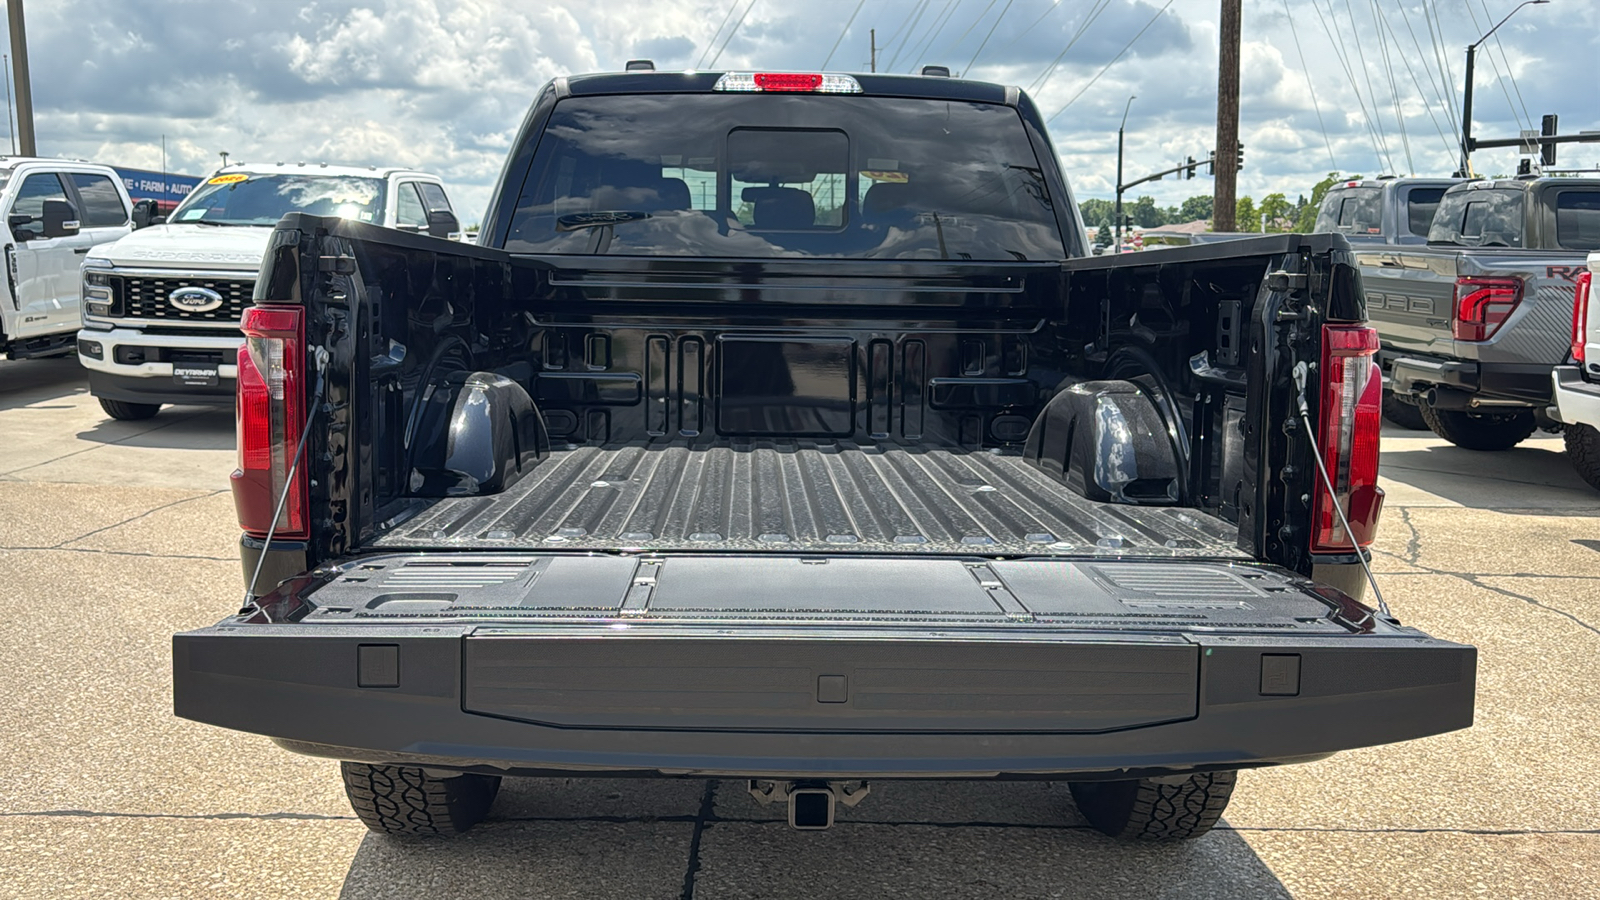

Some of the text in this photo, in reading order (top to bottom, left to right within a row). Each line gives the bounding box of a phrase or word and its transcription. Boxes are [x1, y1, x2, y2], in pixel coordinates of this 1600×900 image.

[140, 180, 165, 193] FARM
[171, 183, 193, 194] AUTO
[182, 294, 206, 305] Ford
